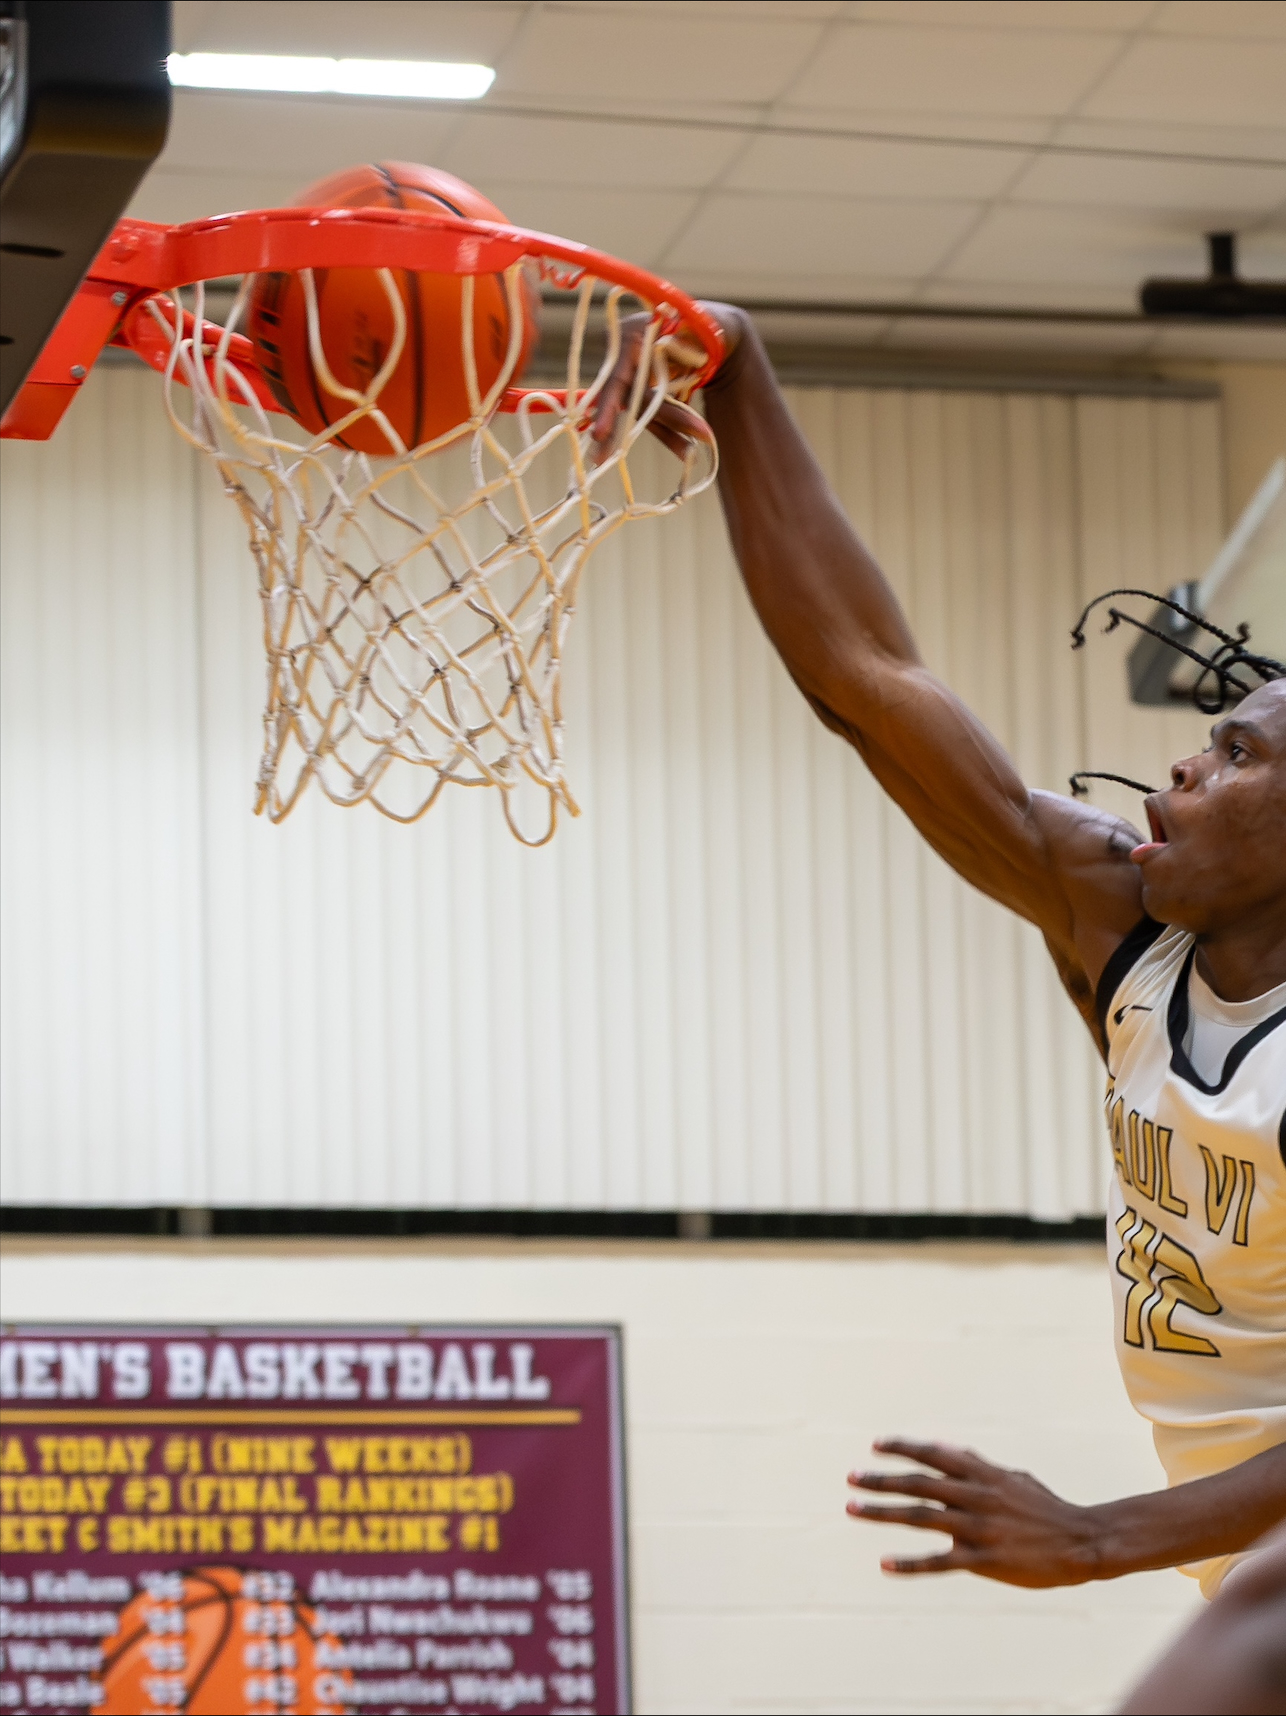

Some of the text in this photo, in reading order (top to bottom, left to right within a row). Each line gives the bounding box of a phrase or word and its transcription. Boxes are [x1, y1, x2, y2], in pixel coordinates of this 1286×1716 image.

[1104, 1072, 1255, 1247] AUL VI
[165, 1342, 550, 1400] BASKETBALL
[35, 1435, 152, 1473] TODAY
[163, 1435, 201, 1473] #1
[210, 1432, 316, 1474] (NINE
[325, 1431, 472, 1474] WEEKS)
[0, 1475, 111, 1513] TODAY
[179, 1473, 308, 1514] (FINAL
[316, 1472, 514, 1514] RANKINGS)
[107, 1515, 254, 1552] SMITH'S
[262, 1515, 449, 1552] MAGAZINE
[459, 1515, 499, 1552] #1
[310, 1569, 449, 1600] Alexandra
